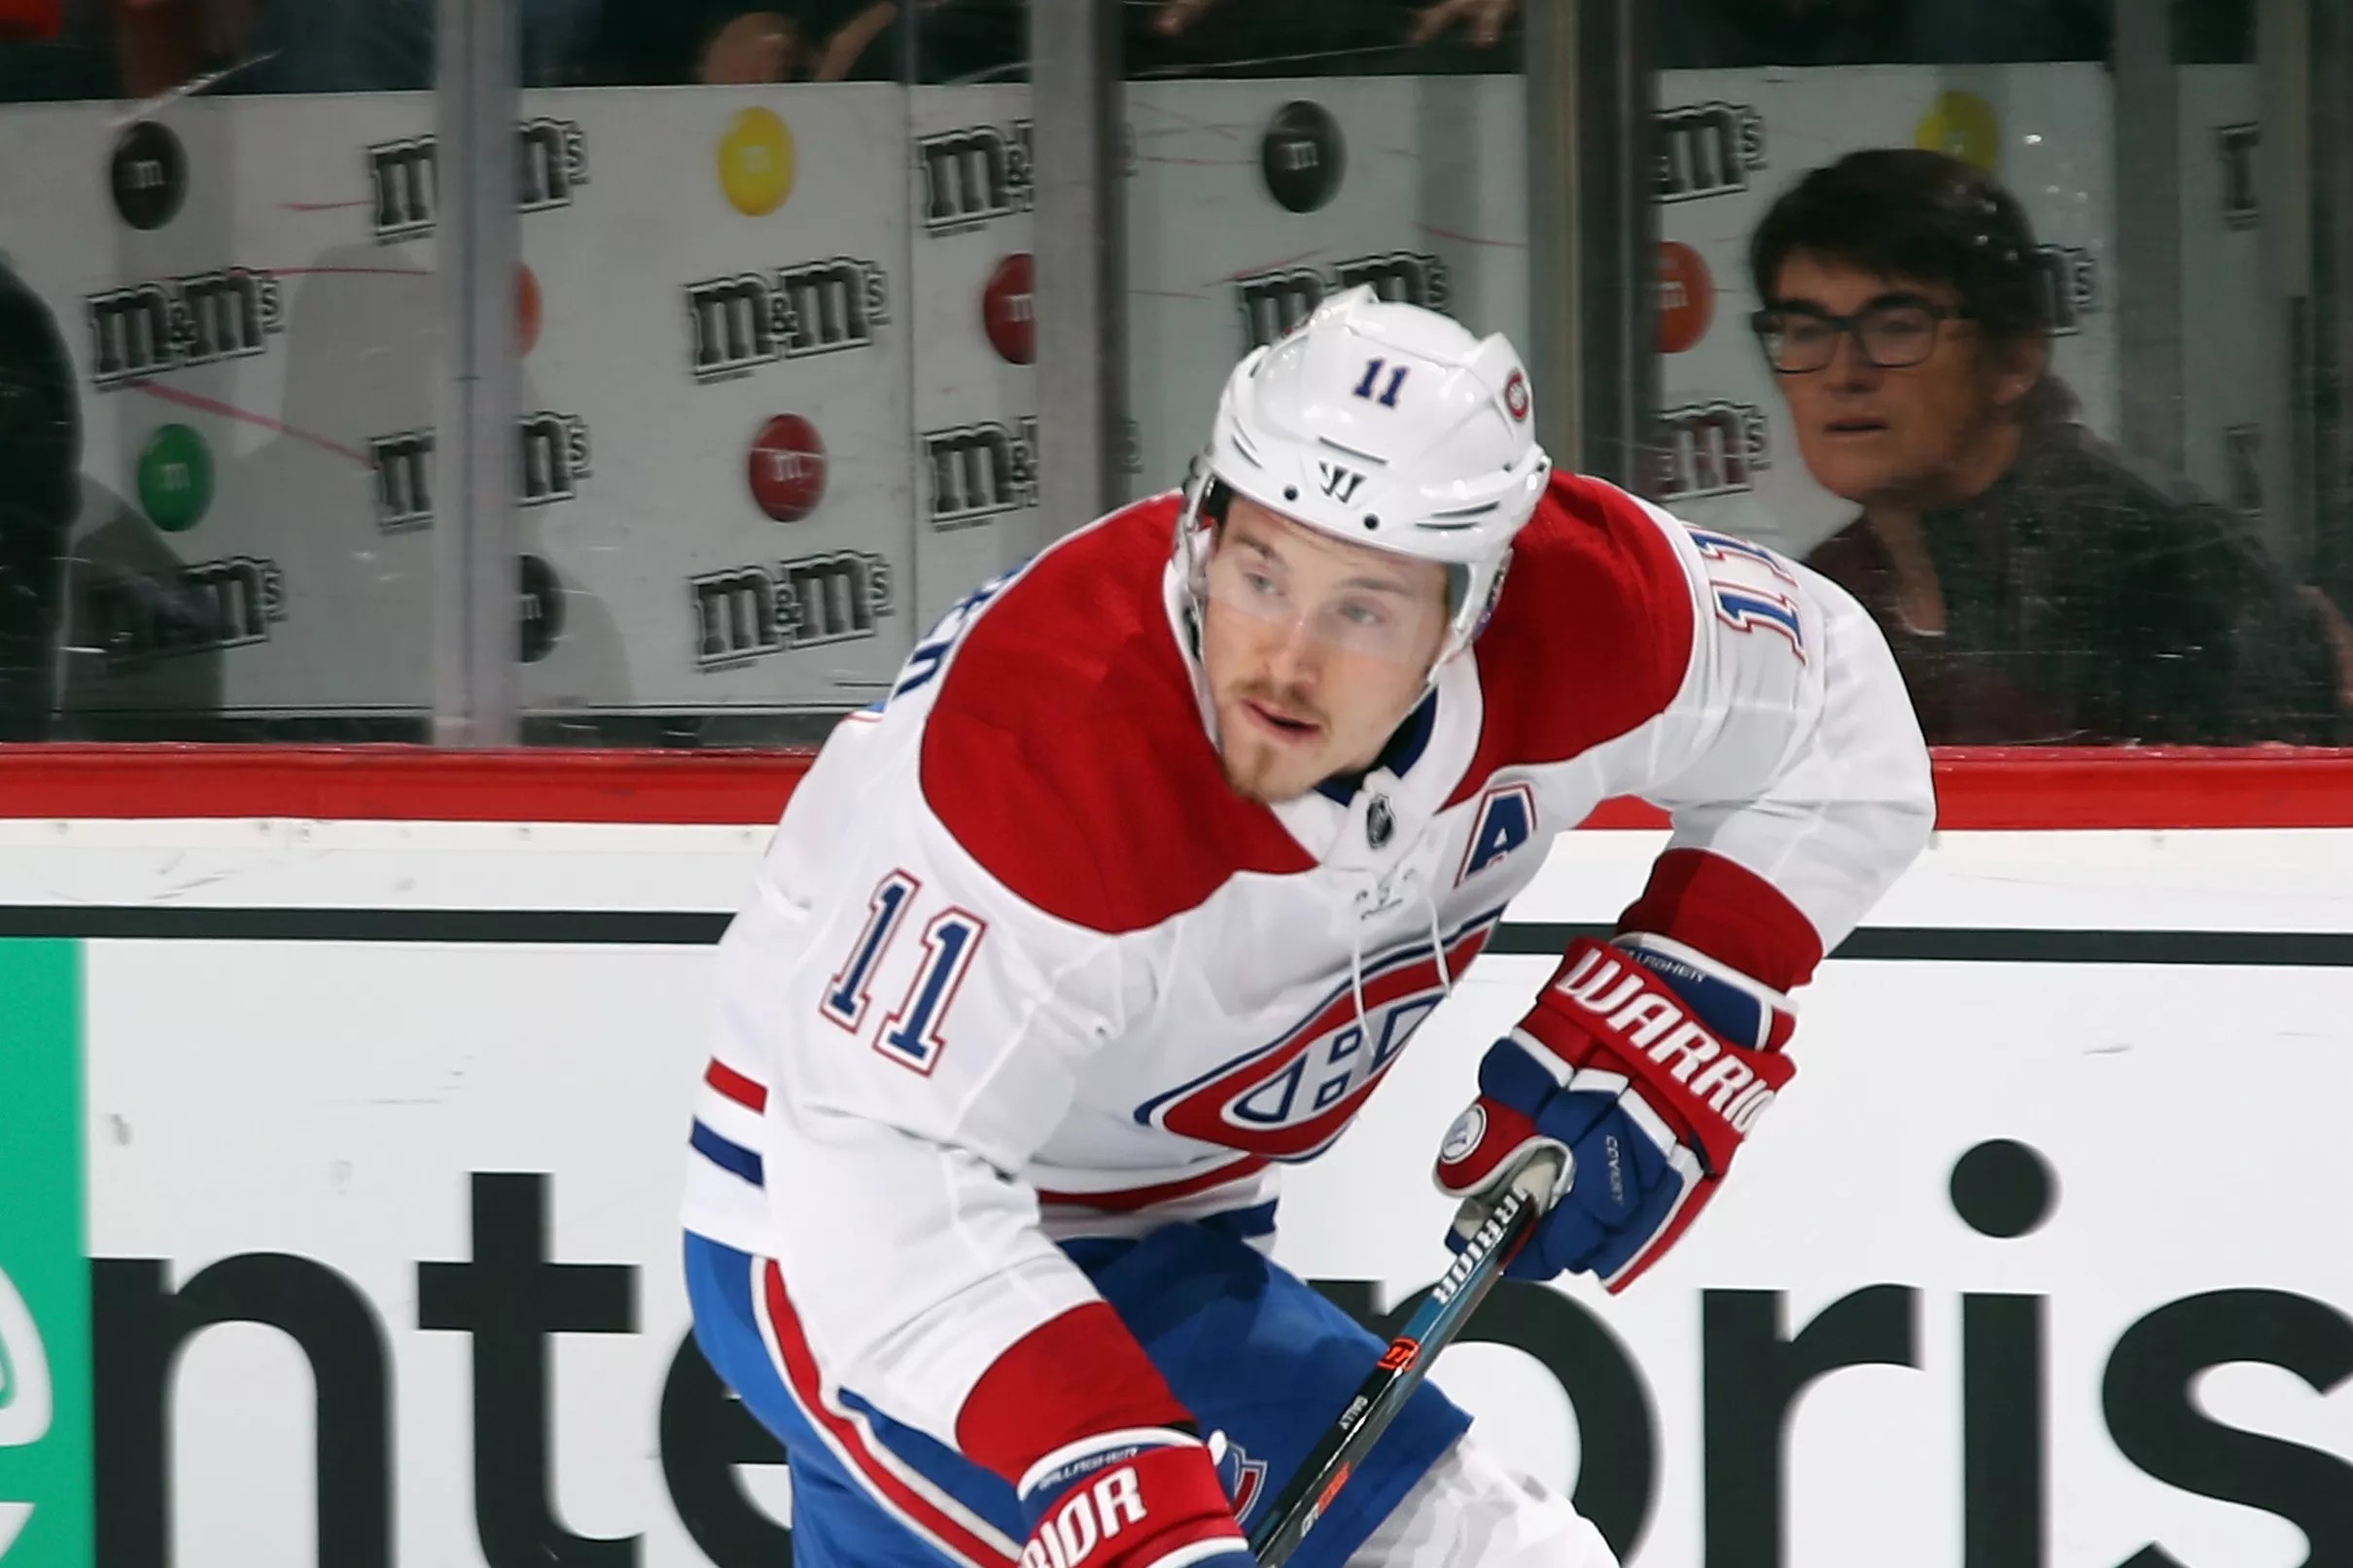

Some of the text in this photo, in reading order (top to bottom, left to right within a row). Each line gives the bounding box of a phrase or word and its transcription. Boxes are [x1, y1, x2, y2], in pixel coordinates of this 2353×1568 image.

[1352, 357, 1411, 409] 11
[1455, 784, 1537, 889] A
[818, 866, 990, 1079] 11
[1020, 1466, 1148, 1568] RIOR
